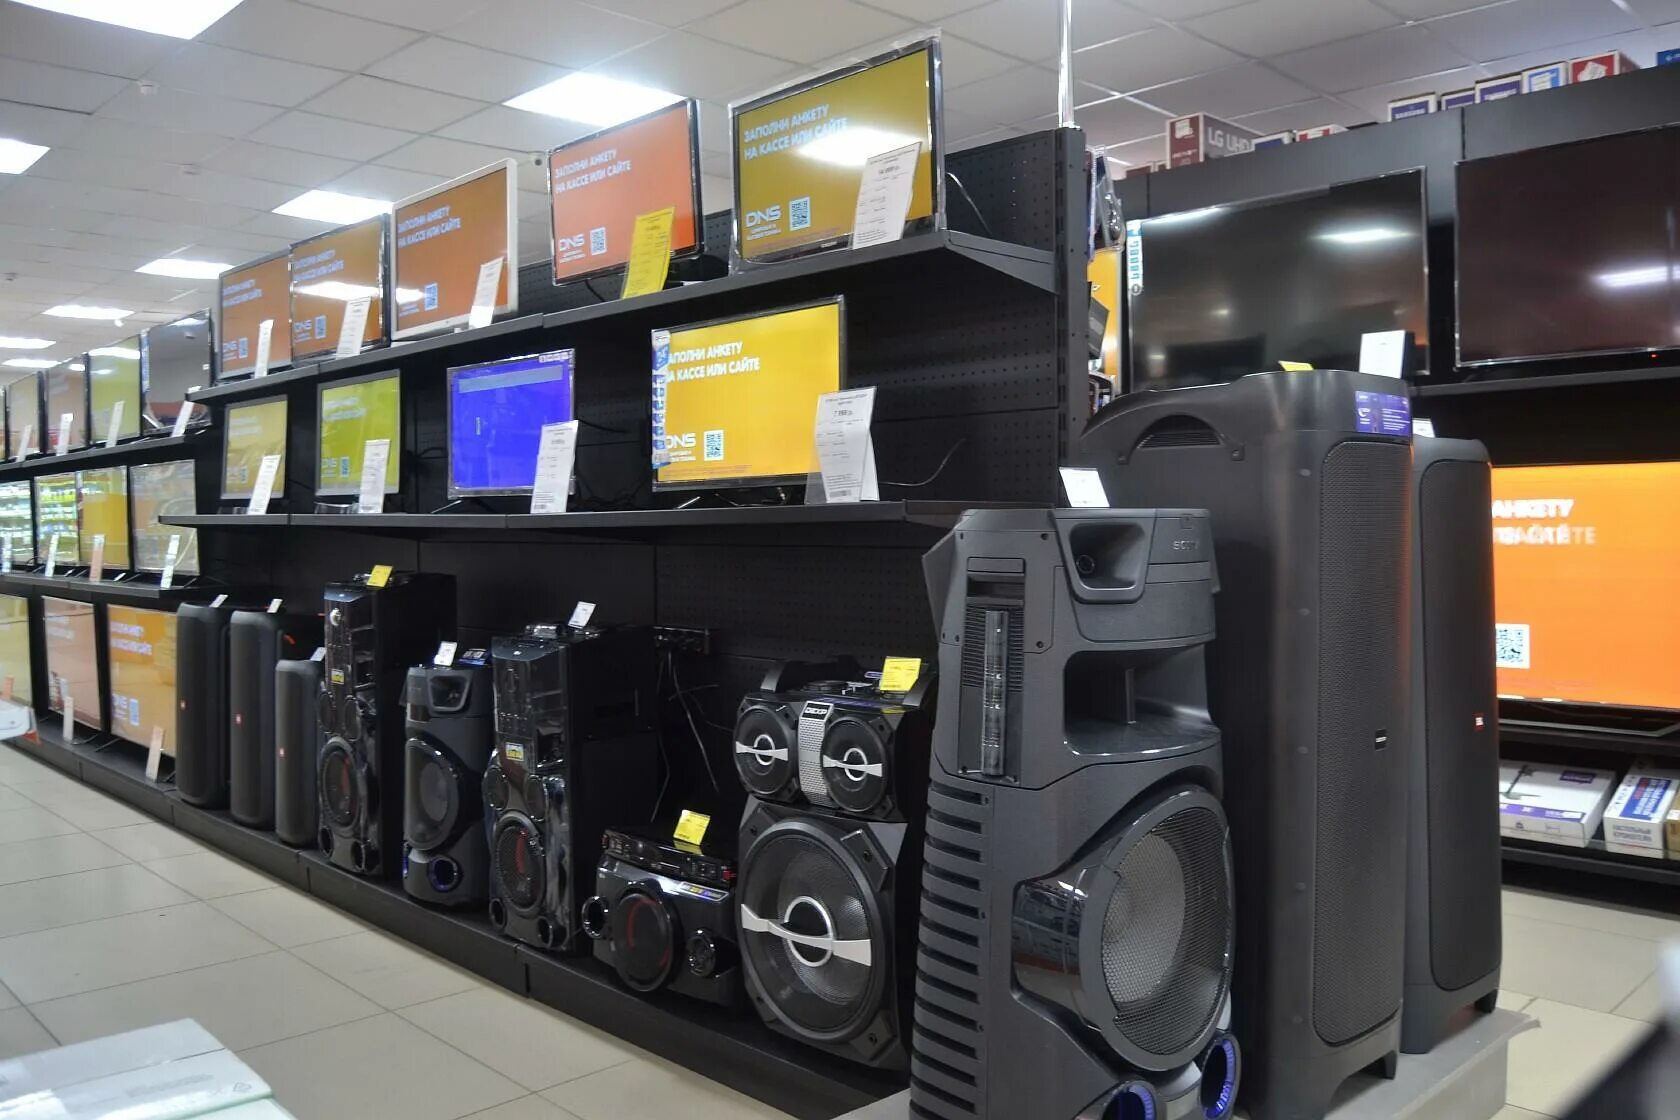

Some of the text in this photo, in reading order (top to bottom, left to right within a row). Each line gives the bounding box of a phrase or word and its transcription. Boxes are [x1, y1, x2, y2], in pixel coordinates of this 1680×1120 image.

[744, 104, 829, 142] ЗАПОЛНИ АНКЕТУ
[744, 148, 758, 160] НА
[759, 136, 790, 156] КАССЕ
[814, 118, 848, 139] САЙТЕ
[1208, 127, 1224, 148] LG
[567, 174, 590, 190] КАССЕ
[607, 160, 632, 177] САЙТЕ
[746, 205, 781, 228] DNS
[559, 233, 585, 251] DNS
[707, 341, 743, 360] АНКЕТУ
[677, 366, 705, 382] КАССЕ
[706, 364, 727, 377] ИЛИ
[729, 356, 760, 373] САЙТЕ
[665, 432, 696, 449] DNS
[1491, 498, 1574, 520] АНКЕТУ
